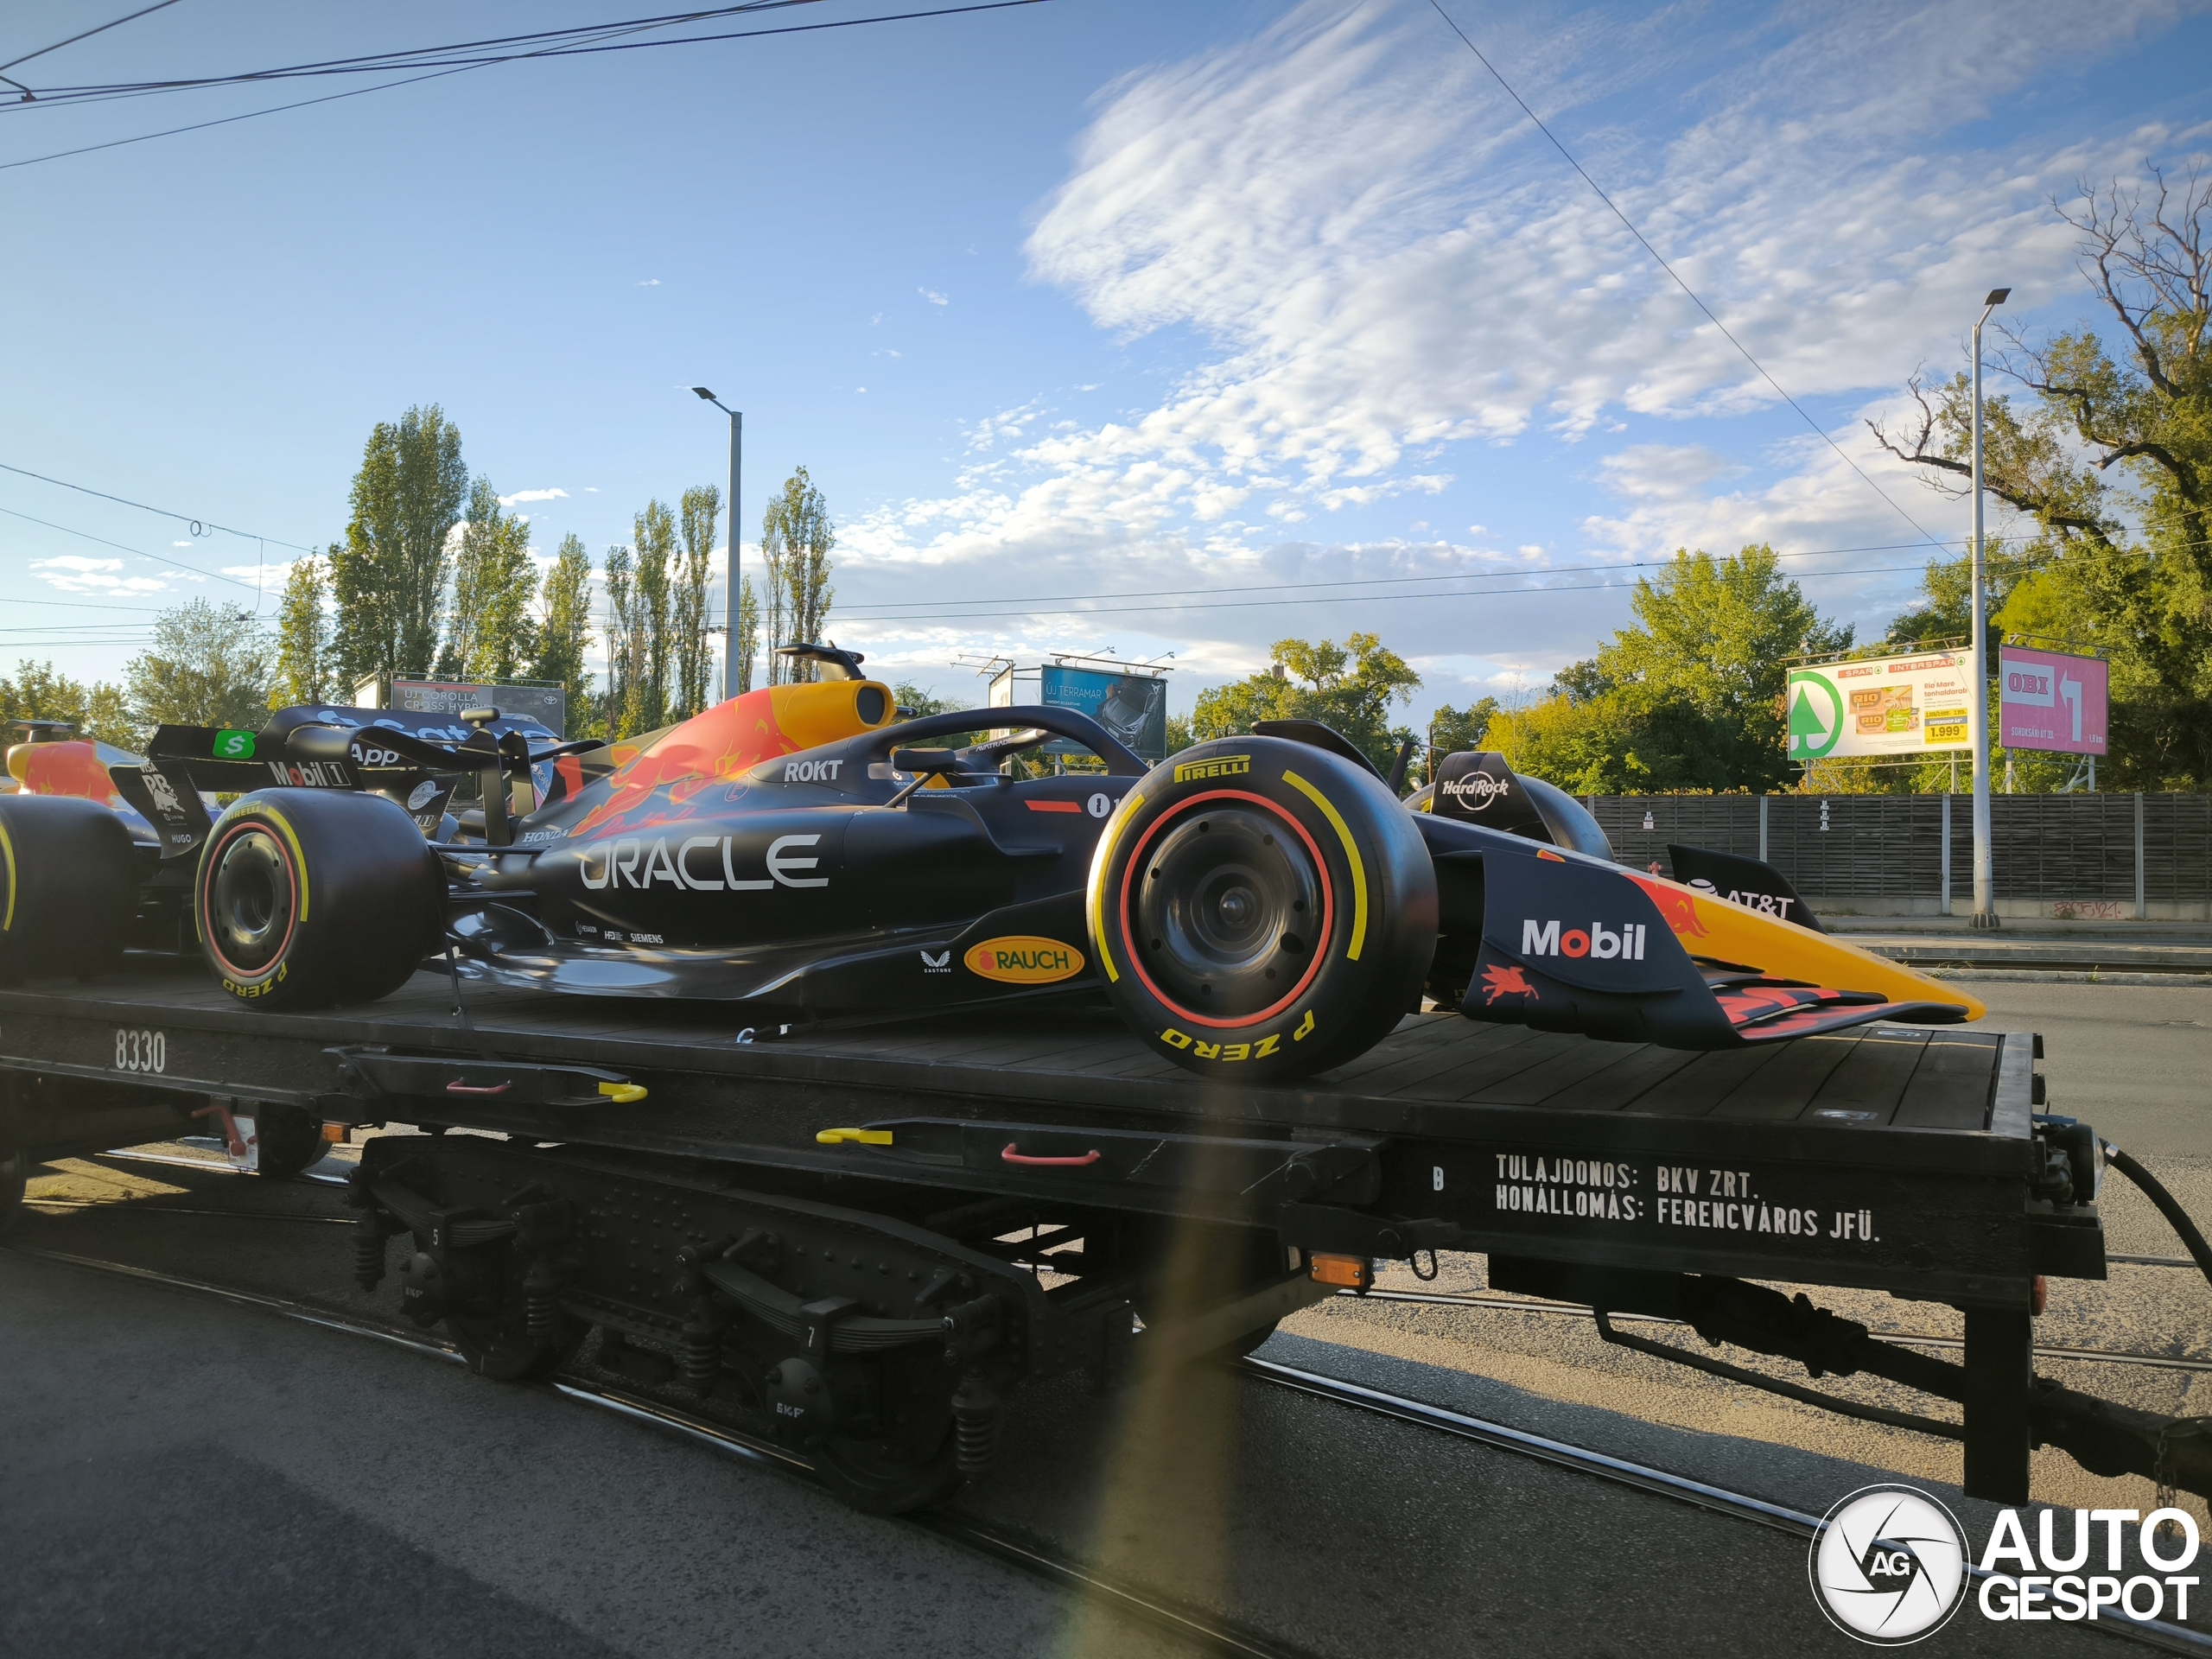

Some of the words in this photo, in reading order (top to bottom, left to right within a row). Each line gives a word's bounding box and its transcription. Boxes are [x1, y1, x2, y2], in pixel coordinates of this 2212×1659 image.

[1846, 669, 1872, 677] SPAR
[1894, 658, 1955, 671] INTERSPAR
[1046, 682, 1057, 696] ÚJ
[1058, 685, 1102, 699] TERRAMAR
[2008, 672, 2049, 695] OBI
[404, 689, 417, 699] ÚJ
[422, 690, 478, 702] COROLLA
[1853, 694, 1878, 703] RIO
[404, 700, 445, 711] CROSS
[1860, 715, 1882, 724] RIO
[1930, 726, 1960, 737] 1.999
[2011, 726, 2039, 738] SOROKSÁRI
[140, 762, 159, 773] VISA
[268, 761, 328, 786] Mobil
[784, 760, 843, 782] ROKT
[1174, 754, 1251, 784] PIRELLI
[1442, 779, 1477, 795] Hard
[1477, 779, 1510, 797] Rock
[172, 835, 192, 843] HUGO
[522, 829, 569, 842] HONDA
[580, 834, 830, 891] ORACLE
[1727, 890, 1795, 919] AT&T
[630, 932, 664, 944] SIEMENS
[1522, 919, 1646, 961] Mobil
[995, 950, 1070, 969] RAUCH
[277, 961, 288, 982] P
[223, 977, 274, 998] ZERO
[1294, 1009, 1315, 1041] P
[116, 1028, 166, 1073] 8330
[1160, 1028, 1281, 1062] ZERO
[1496, 1154, 1638, 1189] TULAJDONOS:
[1656, 1166, 1699, 1195] BKV
[1709, 1170, 1759, 1199] ZRT.
[1496, 1180, 1644, 1222] HONÁLLOMÁS:
[1657, 1198, 1819, 1236] FERENCVÁROS
[1829, 1209, 1881, 1243] JFÜ.
[433, 1228, 439, 1246] 5
[777, 1402, 804, 1418] SKF
